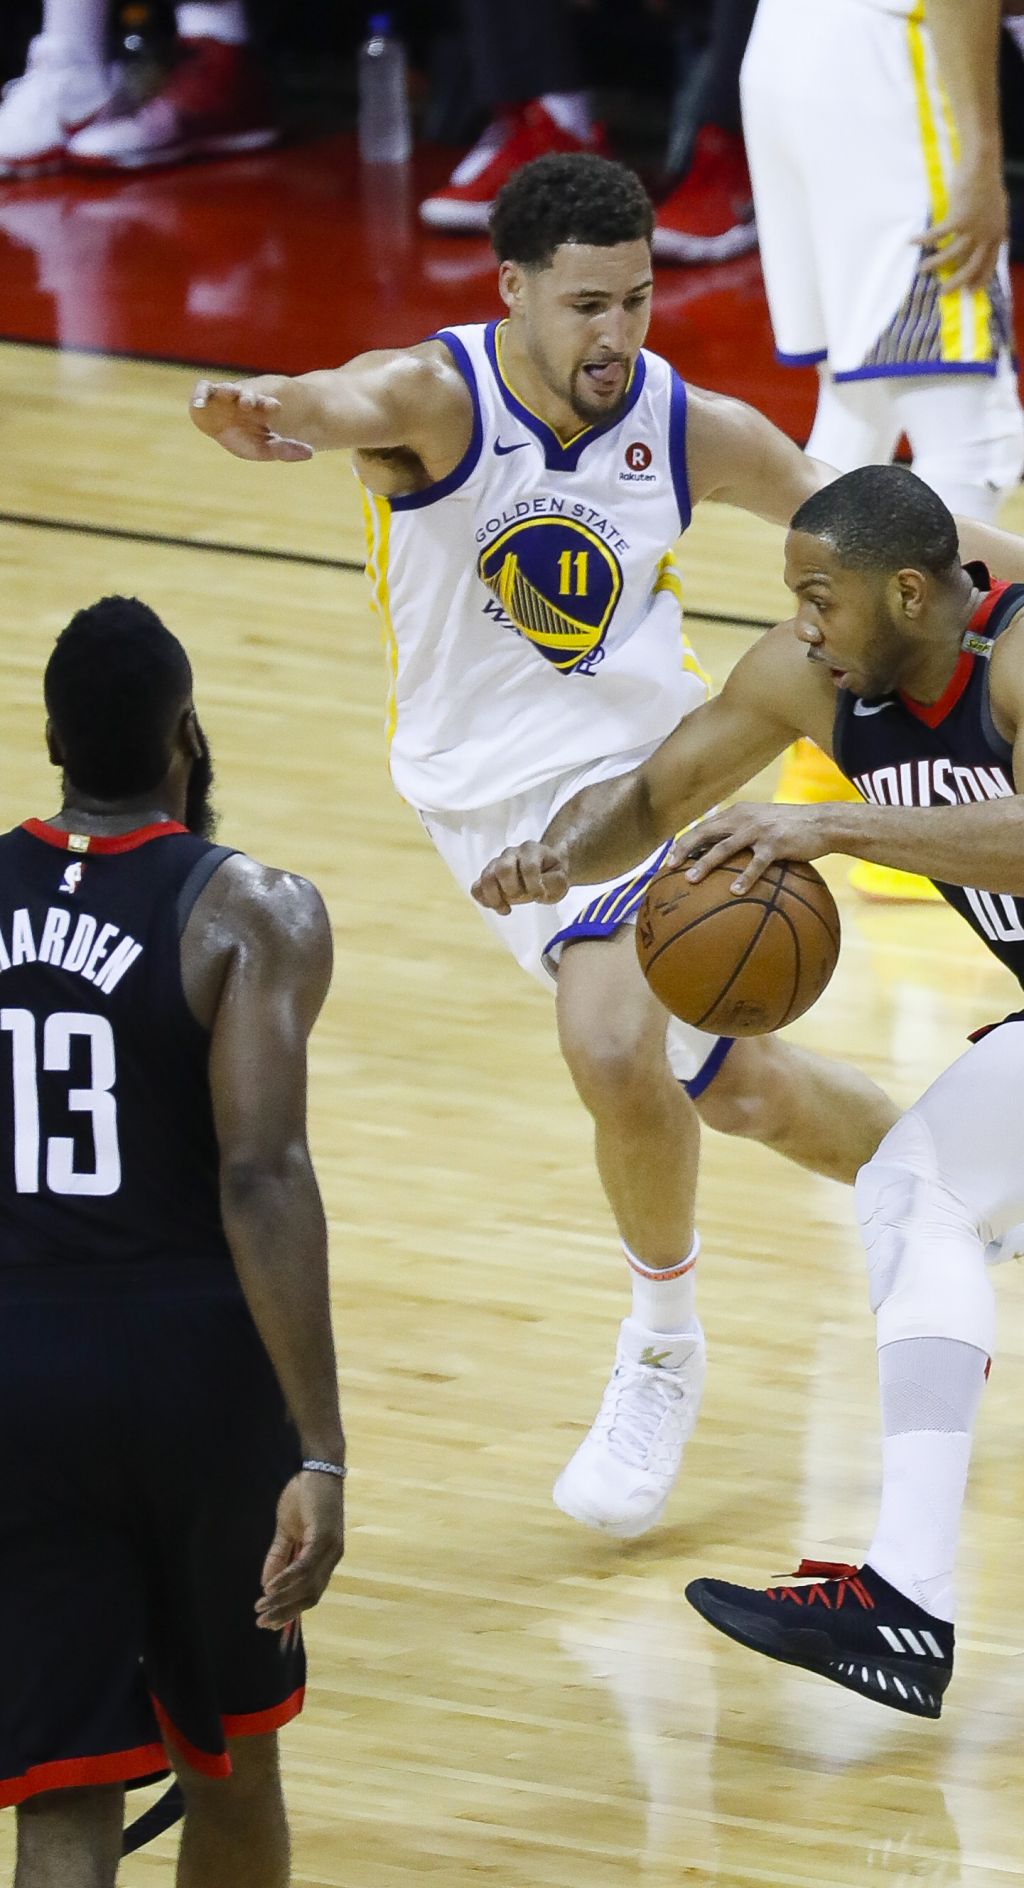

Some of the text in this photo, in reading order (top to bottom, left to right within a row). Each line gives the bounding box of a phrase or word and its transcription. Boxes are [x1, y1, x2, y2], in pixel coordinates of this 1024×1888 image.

[619, 472, 657, 482] Rakuten
[475, 498, 630, 555] GOLDEN STATE
[557, 551, 589, 596] 11
[0, 1008, 122, 1196] 13
